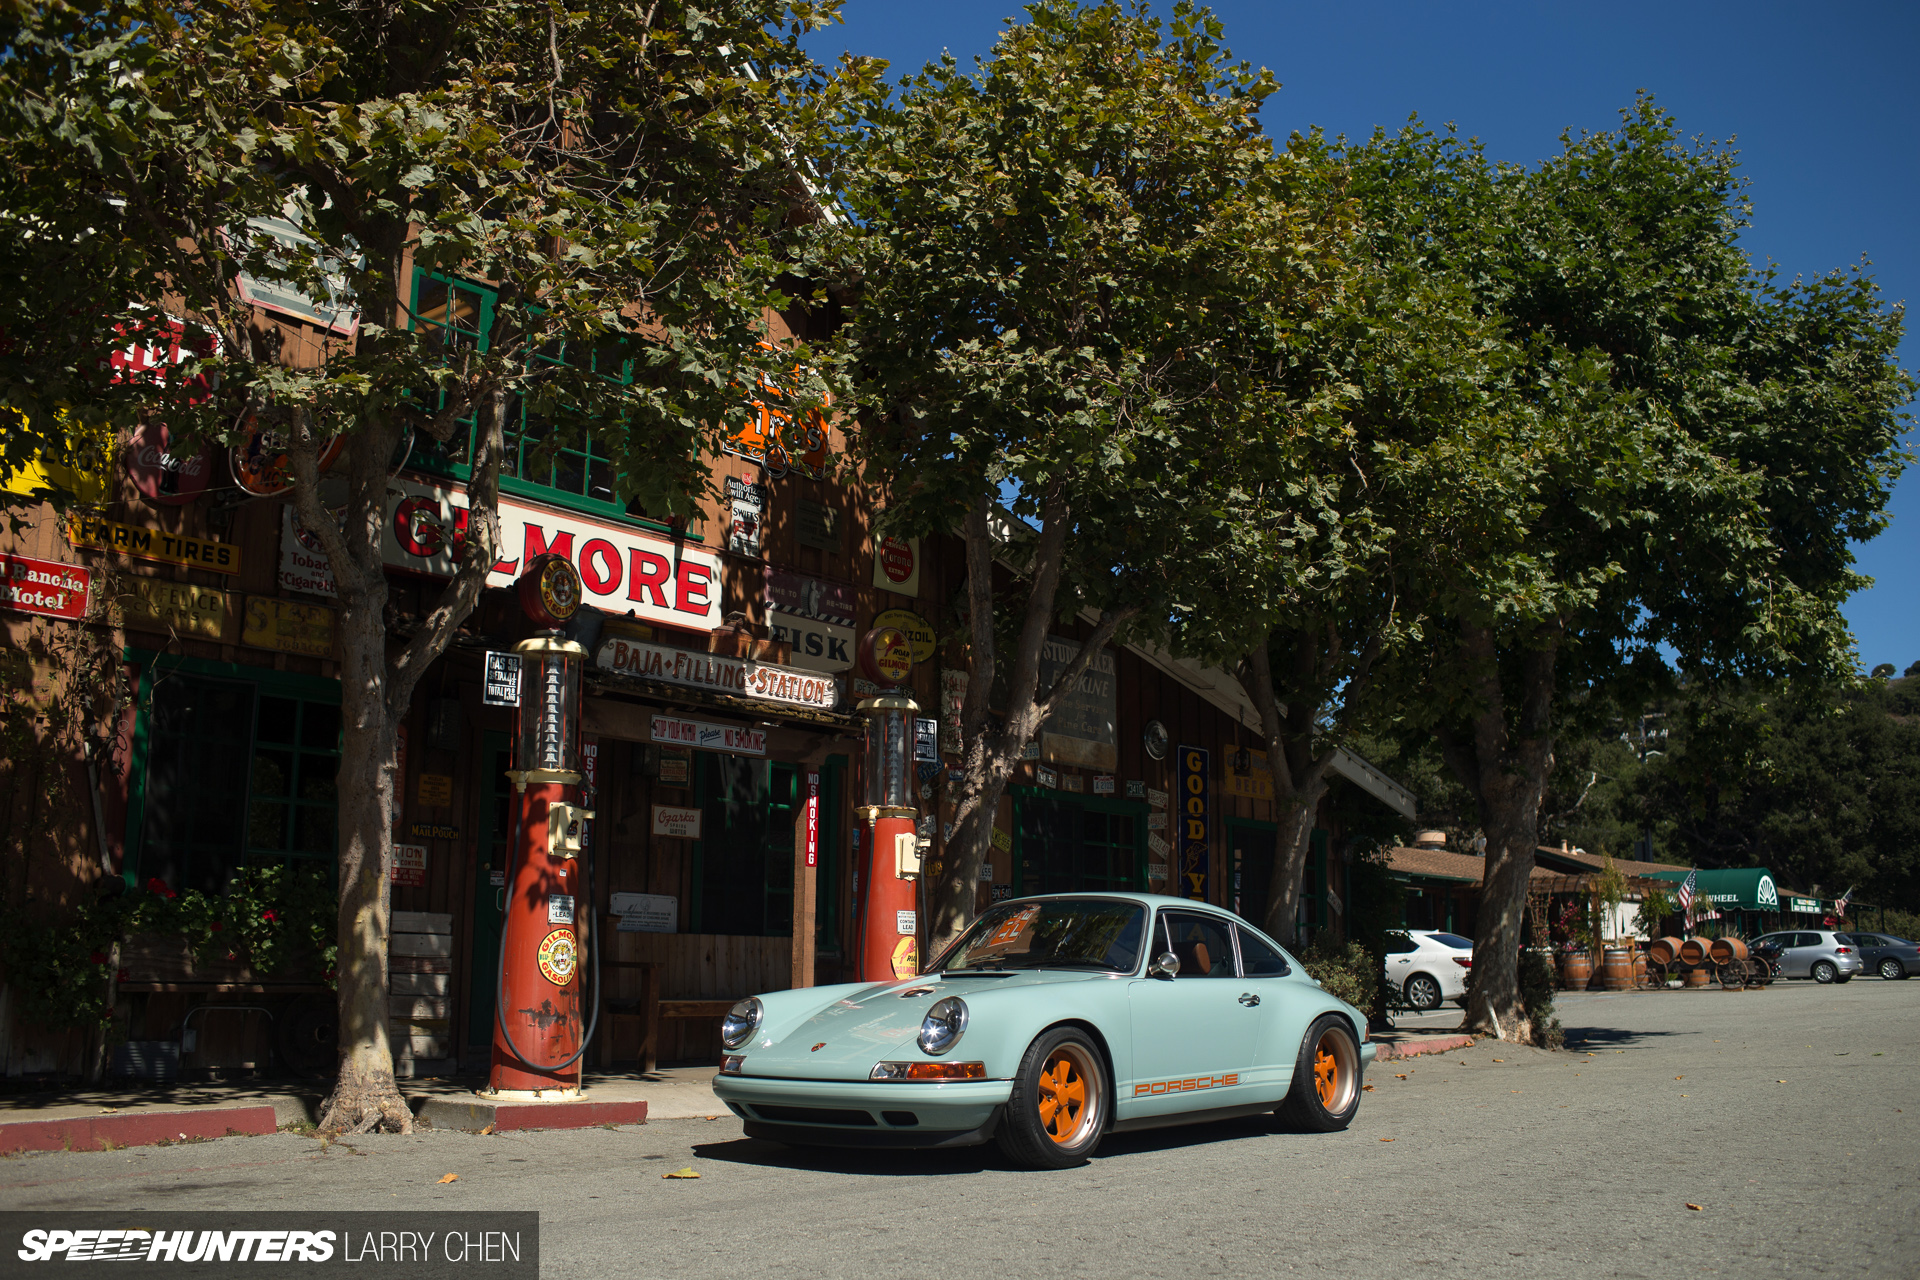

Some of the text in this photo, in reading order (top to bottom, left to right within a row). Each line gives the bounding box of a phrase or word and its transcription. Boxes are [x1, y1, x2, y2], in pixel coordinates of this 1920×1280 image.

[80, 520, 231, 567] FARM TIRES
[393, 495, 713, 617] GIMORE
[882, 548, 912, 569] Corona
[311, 570, 325, 578] and
[888, 566, 905, 577] EXTRA
[0, 583, 65, 610] Motel
[789, 589, 798, 599] TO
[544, 590, 578, 616] GASOLINE
[826, 599, 853, 612] RE-TIRE
[771, 623, 850, 663] FISK
[892, 648, 910, 658] ROAR
[490, 656, 506, 671] GAS
[878, 658, 910, 672] GILMORE
[613, 641, 825, 704] BAJA FILLING STATION
[488, 685, 504, 697] TOTAL
[1051, 669, 1109, 699] EKINE
[655, 719, 666, 738] STOP
[668, 720, 681, 740] YOUR
[725, 728, 734, 747] NO
[734, 729, 764, 751] SMOKING
[583, 743, 598, 758] NO
[808, 773, 820, 785] NO
[1235, 777, 1266, 796] BEER
[658, 809, 696, 828] Ozarka
[808, 785, 819, 865] SMOKING
[412, 824, 459, 840] MAIL POUCH
[669, 828, 687, 836] WATER
[400, 859, 424, 867] CONTROL
[1706, 893, 1739, 903] WHEEL
[1134, 1073, 1239, 1097] PORSCHE
